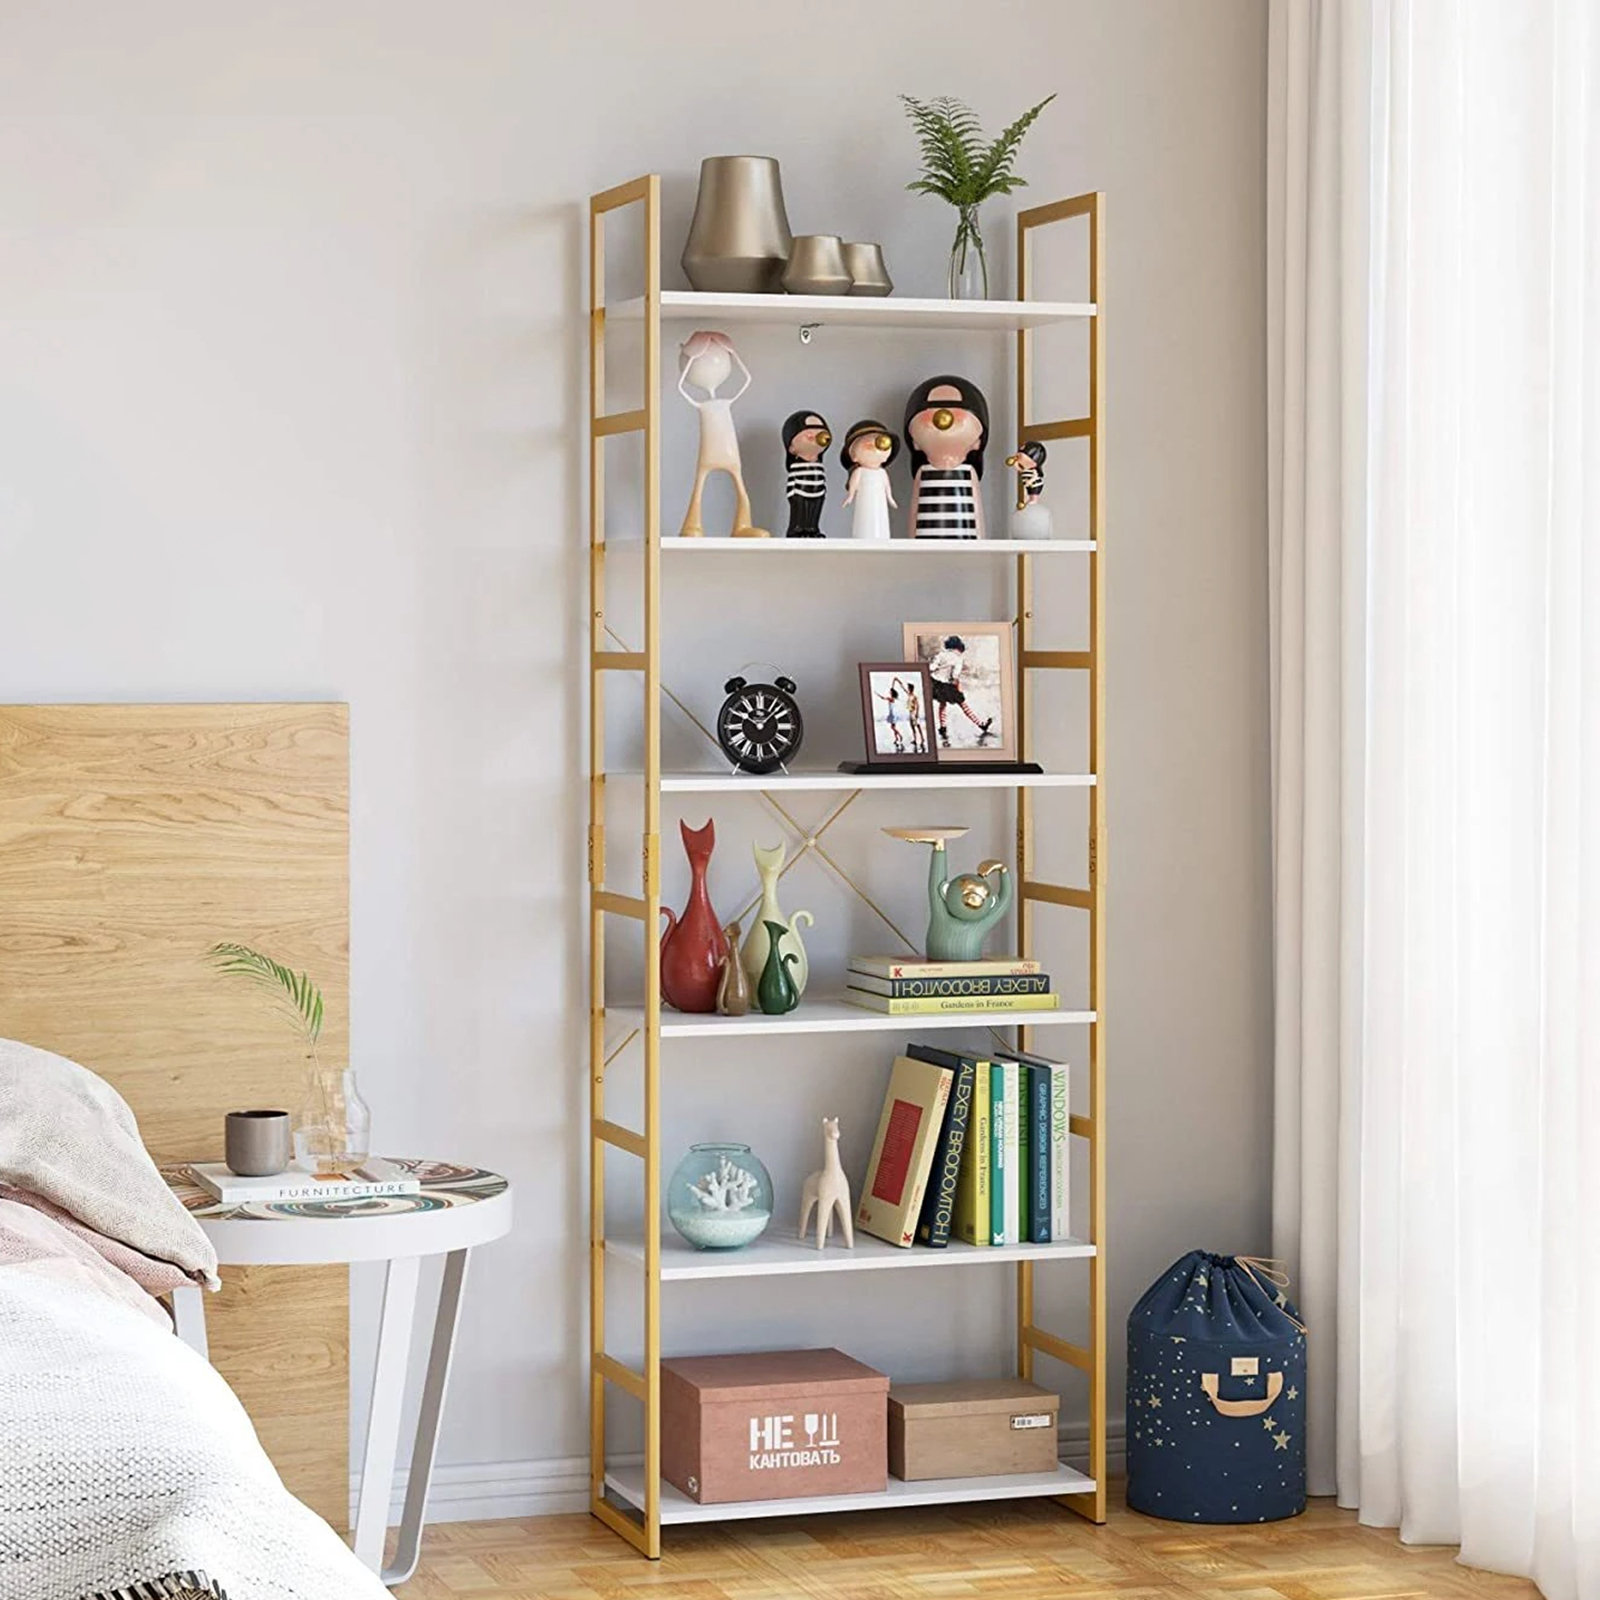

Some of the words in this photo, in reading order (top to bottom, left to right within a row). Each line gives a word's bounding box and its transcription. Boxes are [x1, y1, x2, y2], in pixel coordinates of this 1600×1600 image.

[902, 979, 991, 997] BRODOVITCH
[993, 977, 1047, 994] ALEXEY
[940, 1000, 974, 1009] Gardens
[976, 1000, 984, 1008] in
[986, 999, 1013, 1008] France
[953, 1062, 974, 1127] ALEXEY
[1039, 1083, 1048, 1120] GRAPHIC
[1053, 1070, 1066, 1142] WINDOWS
[979, 1117, 988, 1154] Gardens
[1039, 1122, 1048, 1153] DESIGN
[979, 1155, 987, 1164] in
[279, 1183, 406, 1198] FURNITECTURE
[934, 1130, 964, 1235] BRODOVITCH
[979, 1166, 987, 1195] France
[750, 1415, 794, 1451] НЕ
[749, 1449, 841, 1470] КАНТОВАТЬ
